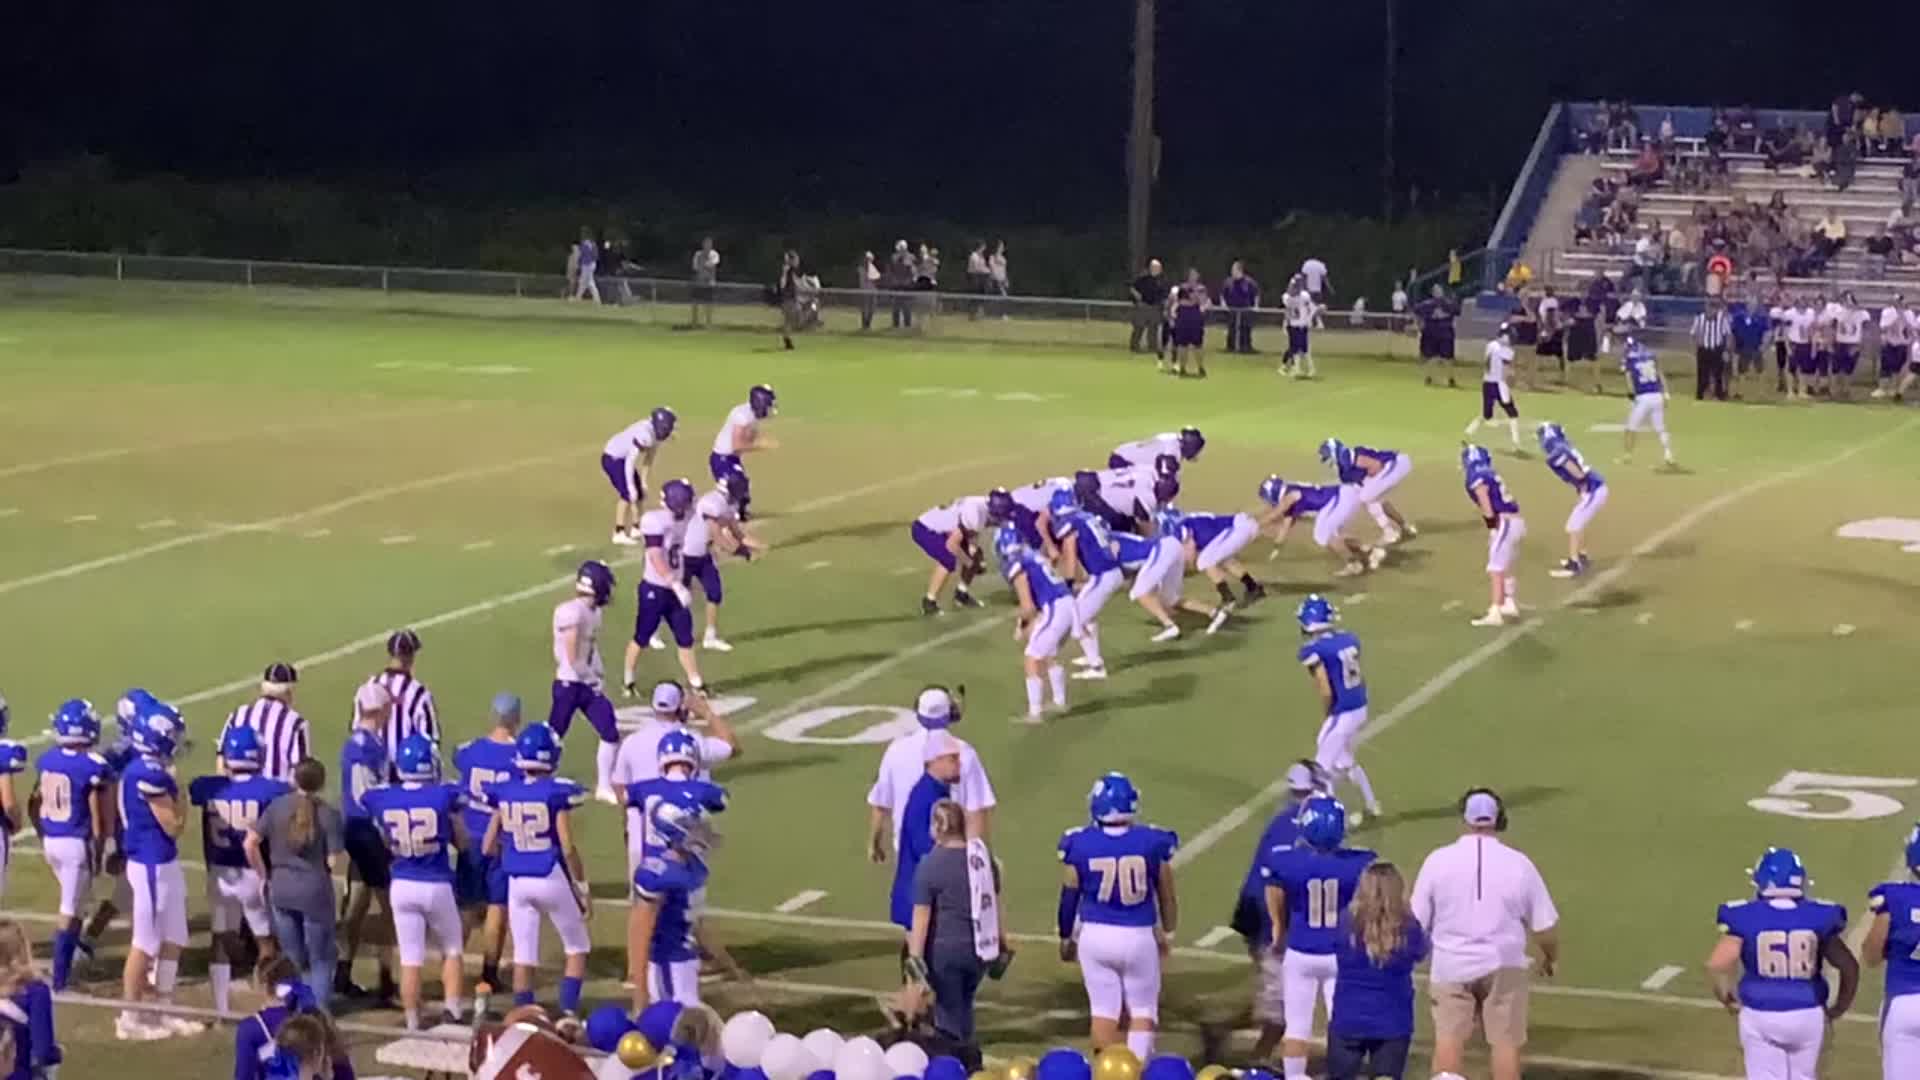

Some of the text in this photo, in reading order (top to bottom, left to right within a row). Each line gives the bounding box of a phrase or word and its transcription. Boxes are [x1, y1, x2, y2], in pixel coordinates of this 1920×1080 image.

[384, 808, 440, 858] 32
[499, 801, 551, 853] 42
[1088, 855, 1148, 906] 70
[1306, 878, 1338, 928] 11
[1757, 929, 1819, 979] 68
